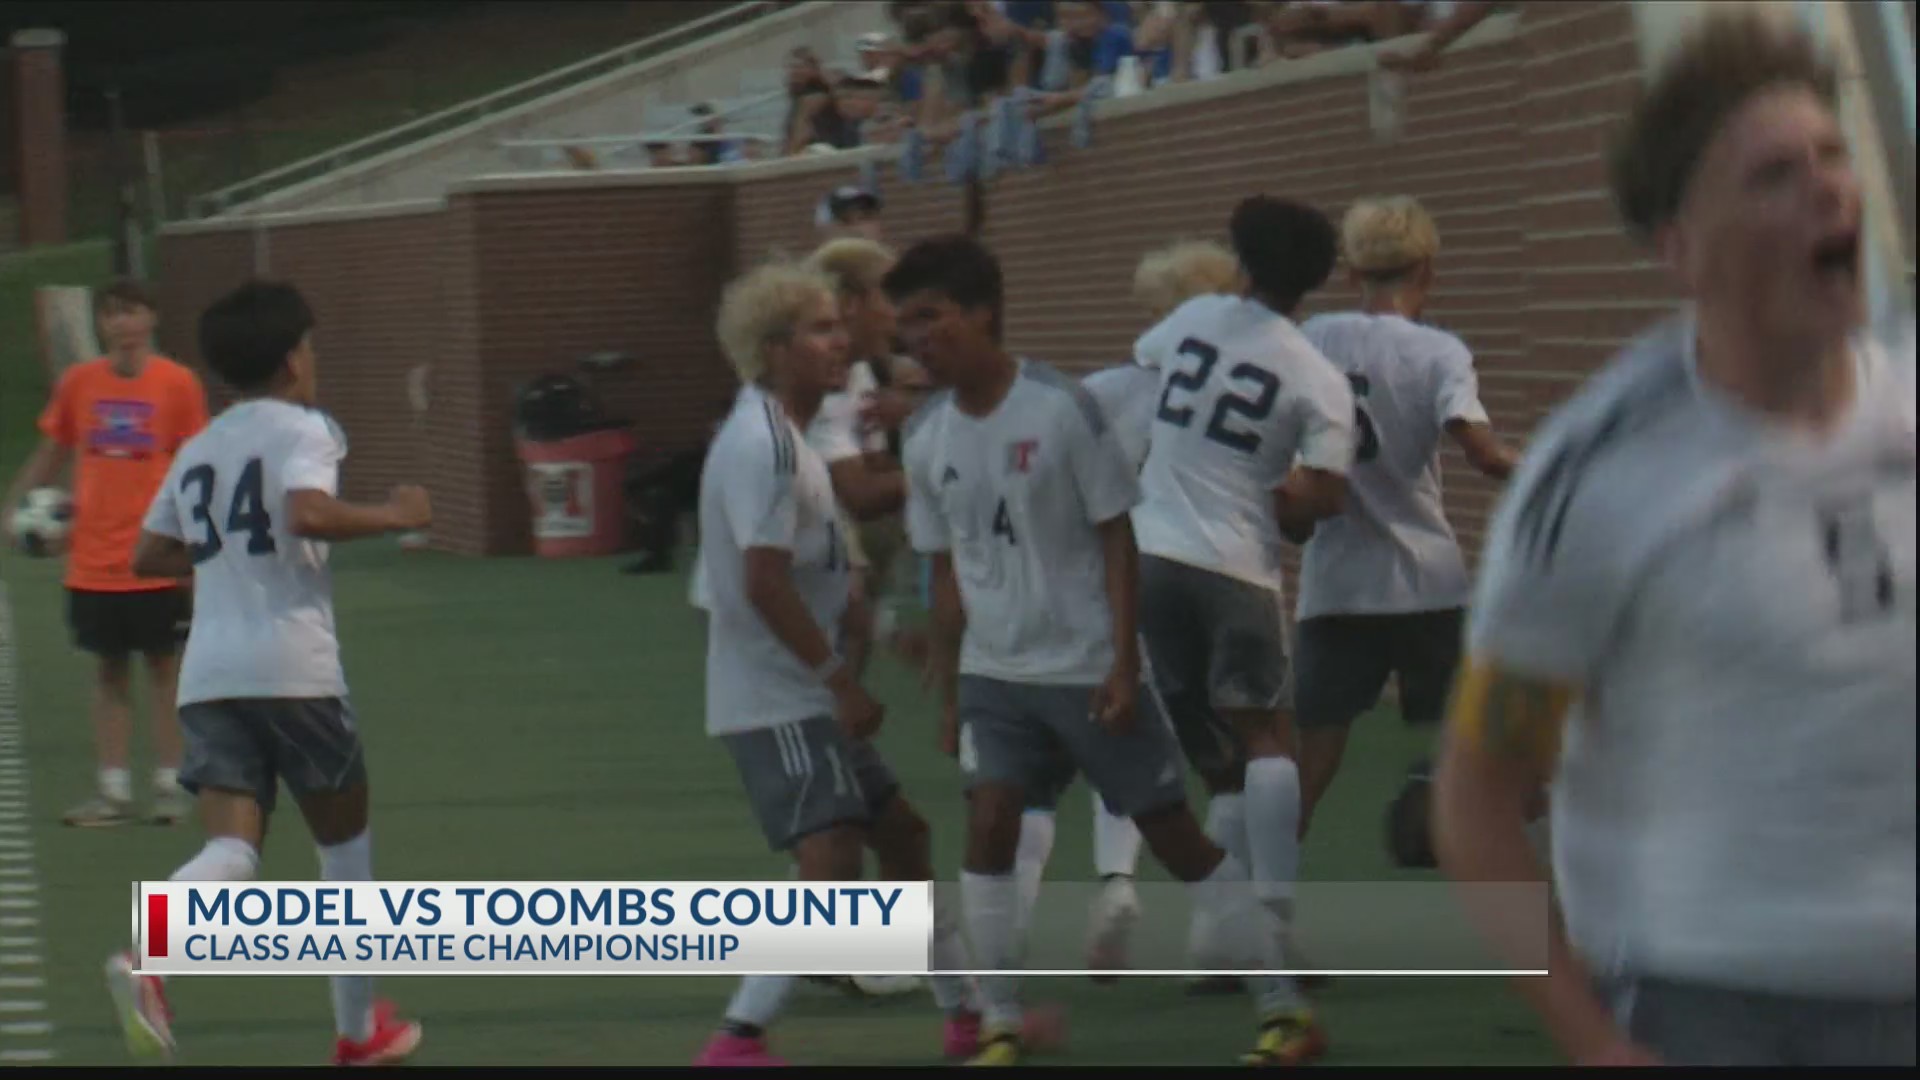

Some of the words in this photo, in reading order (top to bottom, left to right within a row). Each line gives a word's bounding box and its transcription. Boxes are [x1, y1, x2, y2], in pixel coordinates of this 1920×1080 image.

[1157, 336, 1280, 454] 22
[180, 457, 276, 564] 34
[991, 496, 1017, 546] 4
